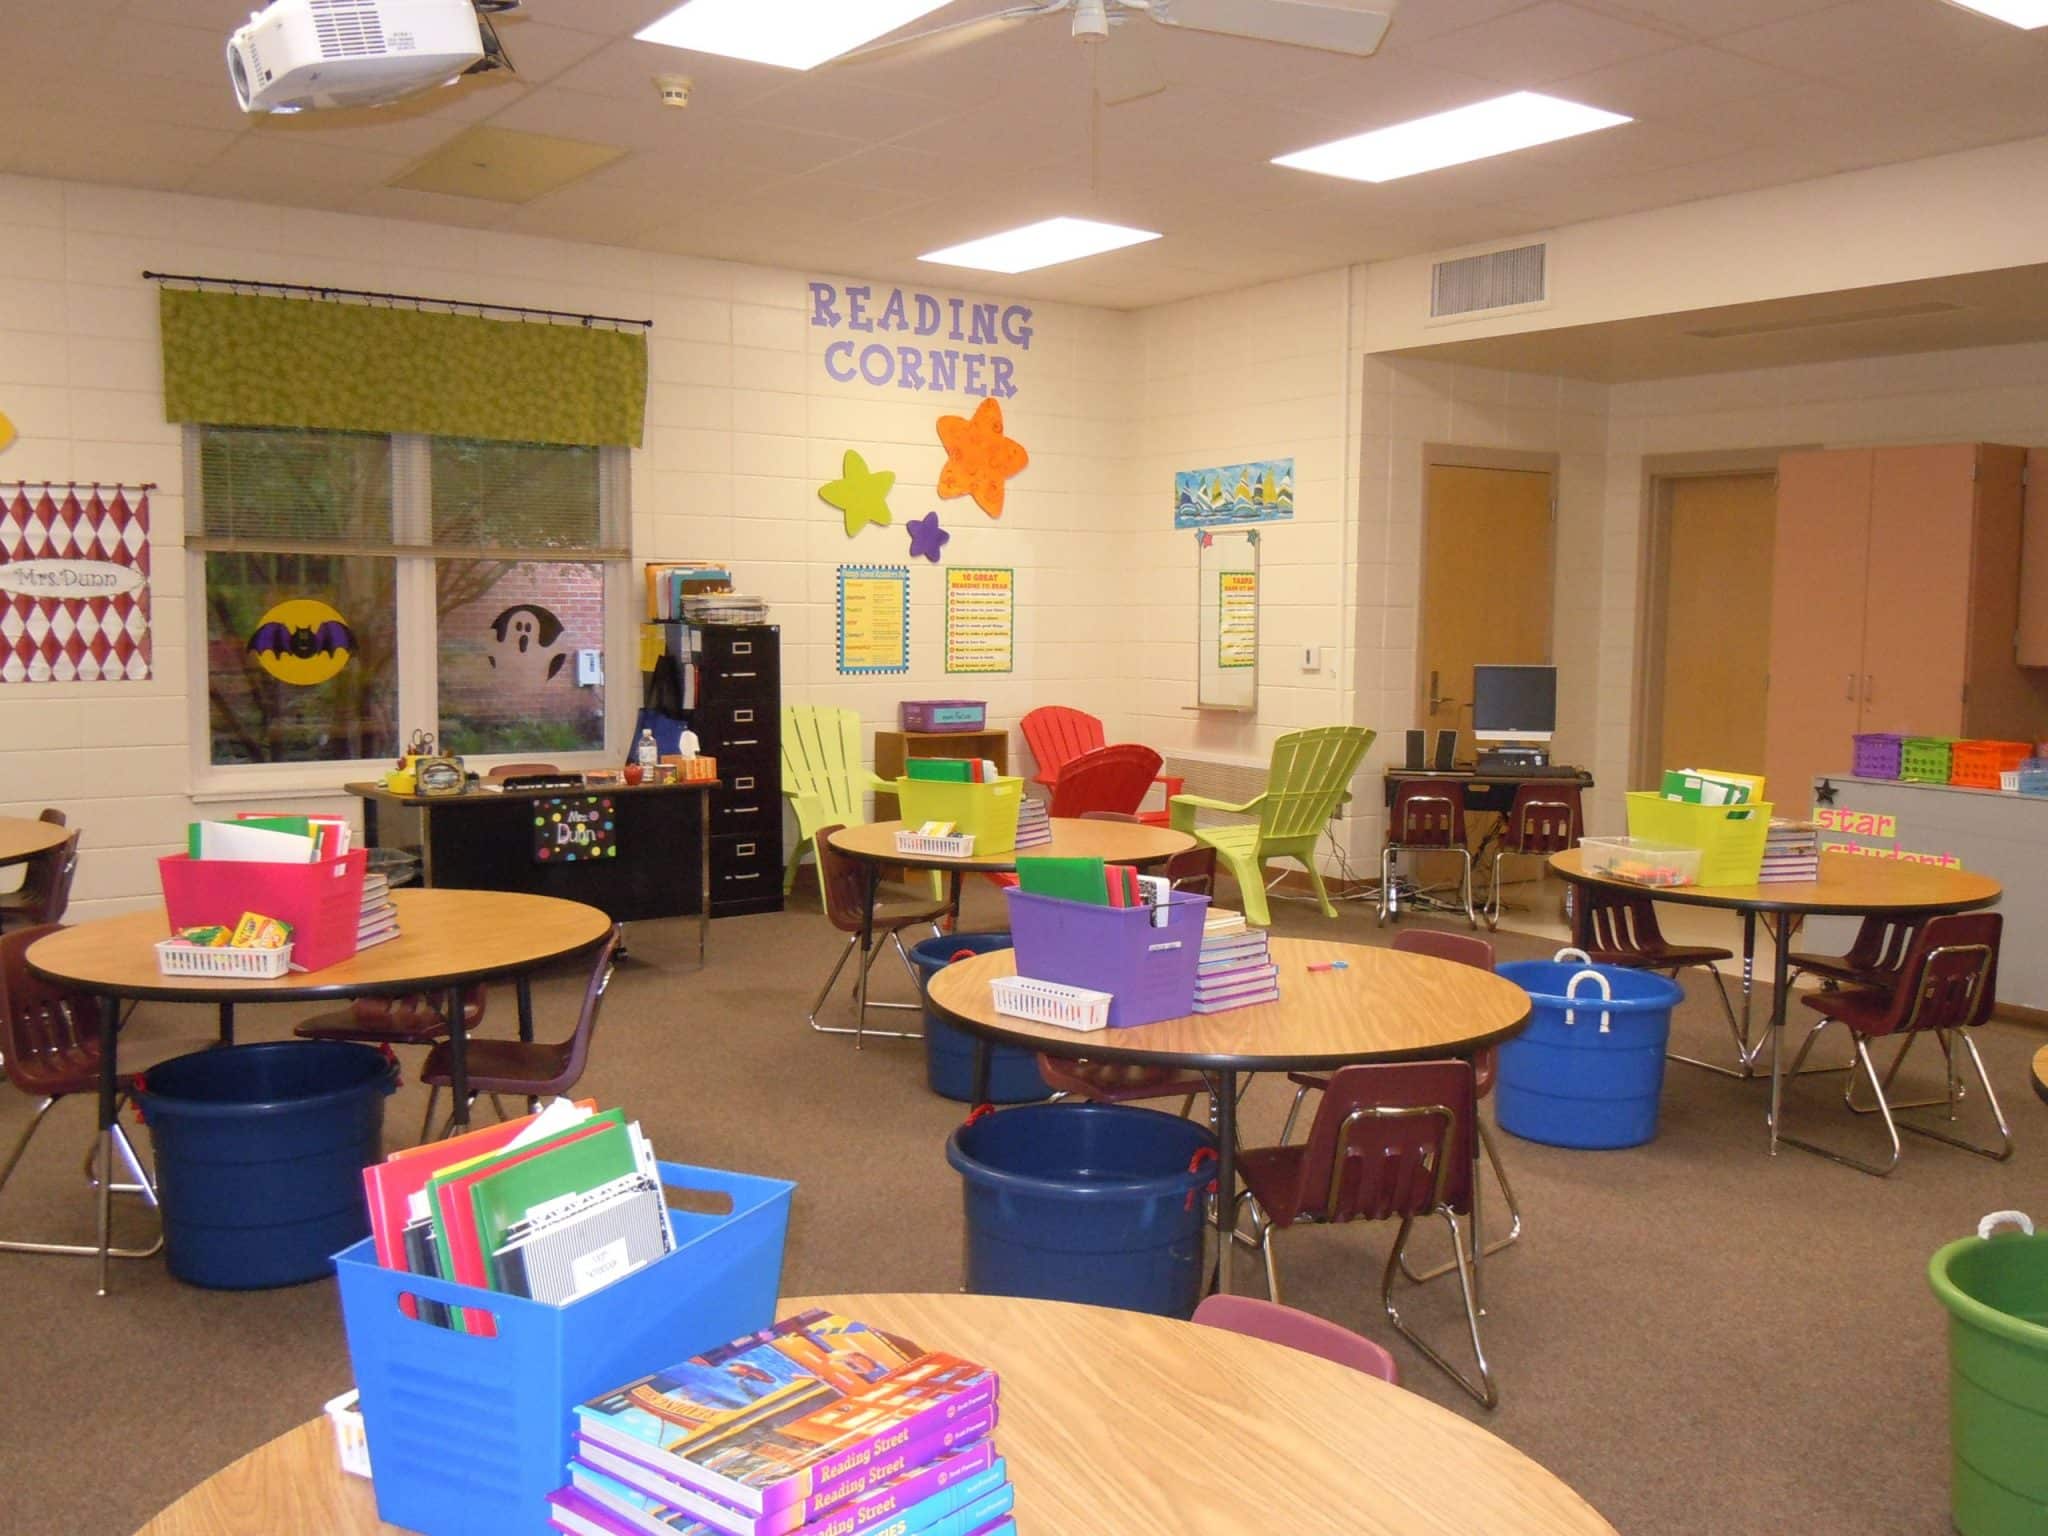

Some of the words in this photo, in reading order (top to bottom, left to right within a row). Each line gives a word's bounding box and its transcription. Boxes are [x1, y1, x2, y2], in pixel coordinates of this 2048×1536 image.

[809, 282, 1034, 350] READING
[824, 340, 1018, 399] CORNER
[59, 569, 117, 587] Dunn
[1818, 805, 1891, 837] star
[820, 1447, 871, 1483] Reading
[873, 1427, 909, 1456] Street
[814, 1476, 866, 1511] Reading
[868, 1456, 905, 1484] Street
[817, 1518, 855, 1536] ading
[857, 1495, 896, 1525] Street
